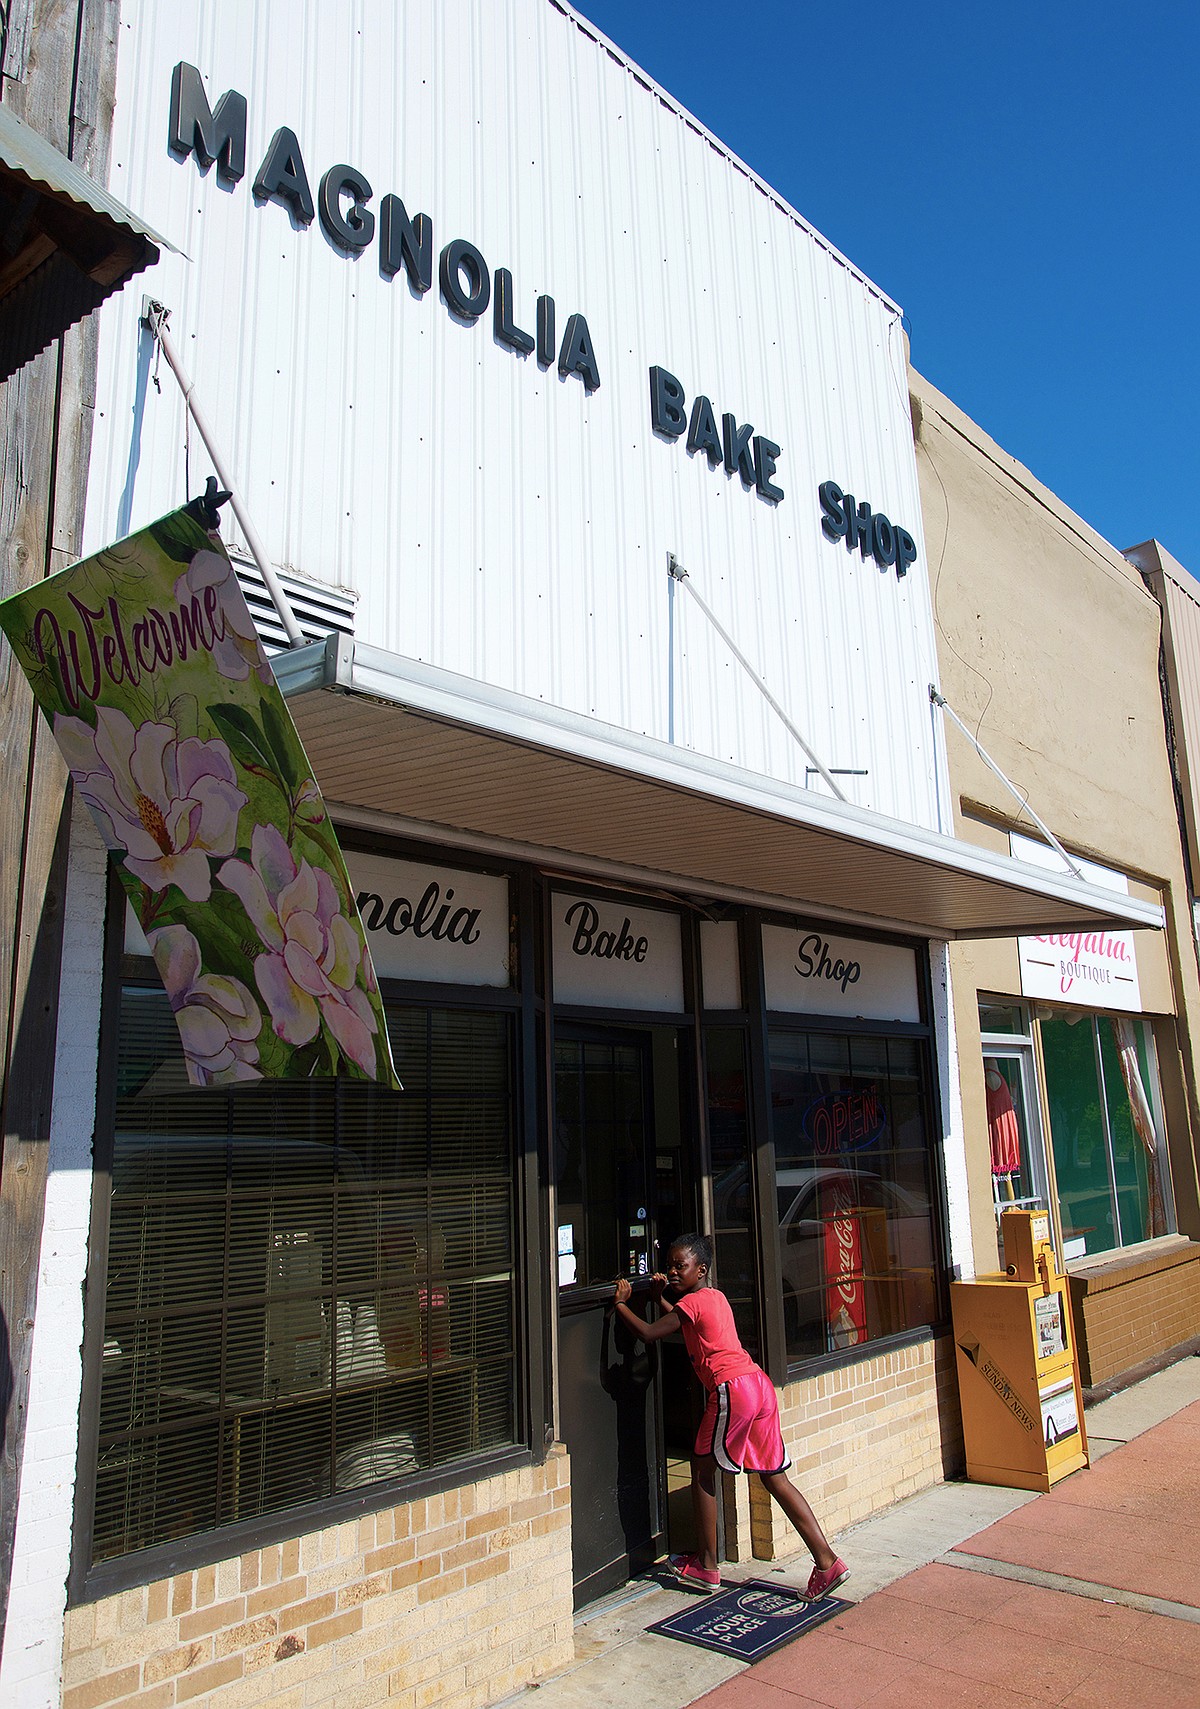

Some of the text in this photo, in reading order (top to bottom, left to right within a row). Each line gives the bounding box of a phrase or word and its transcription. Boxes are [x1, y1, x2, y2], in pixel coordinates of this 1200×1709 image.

[168, 61, 918, 578] MAGNOLIA BAKE SHOP
[34, 585, 226, 709] Welcome
[356, 881, 861, 993] nolia Bake Shop
[1060, 960, 1111, 985] BOUTIQUE
[814, 1082, 879, 1156] OPEN
[981, 1363, 1013, 1401] SUNDAY
[1010, 1401, 1035, 1431] NEWS
[702, 1613, 751, 1637] YOUR
[718, 1618, 768, 1643] PLACE
